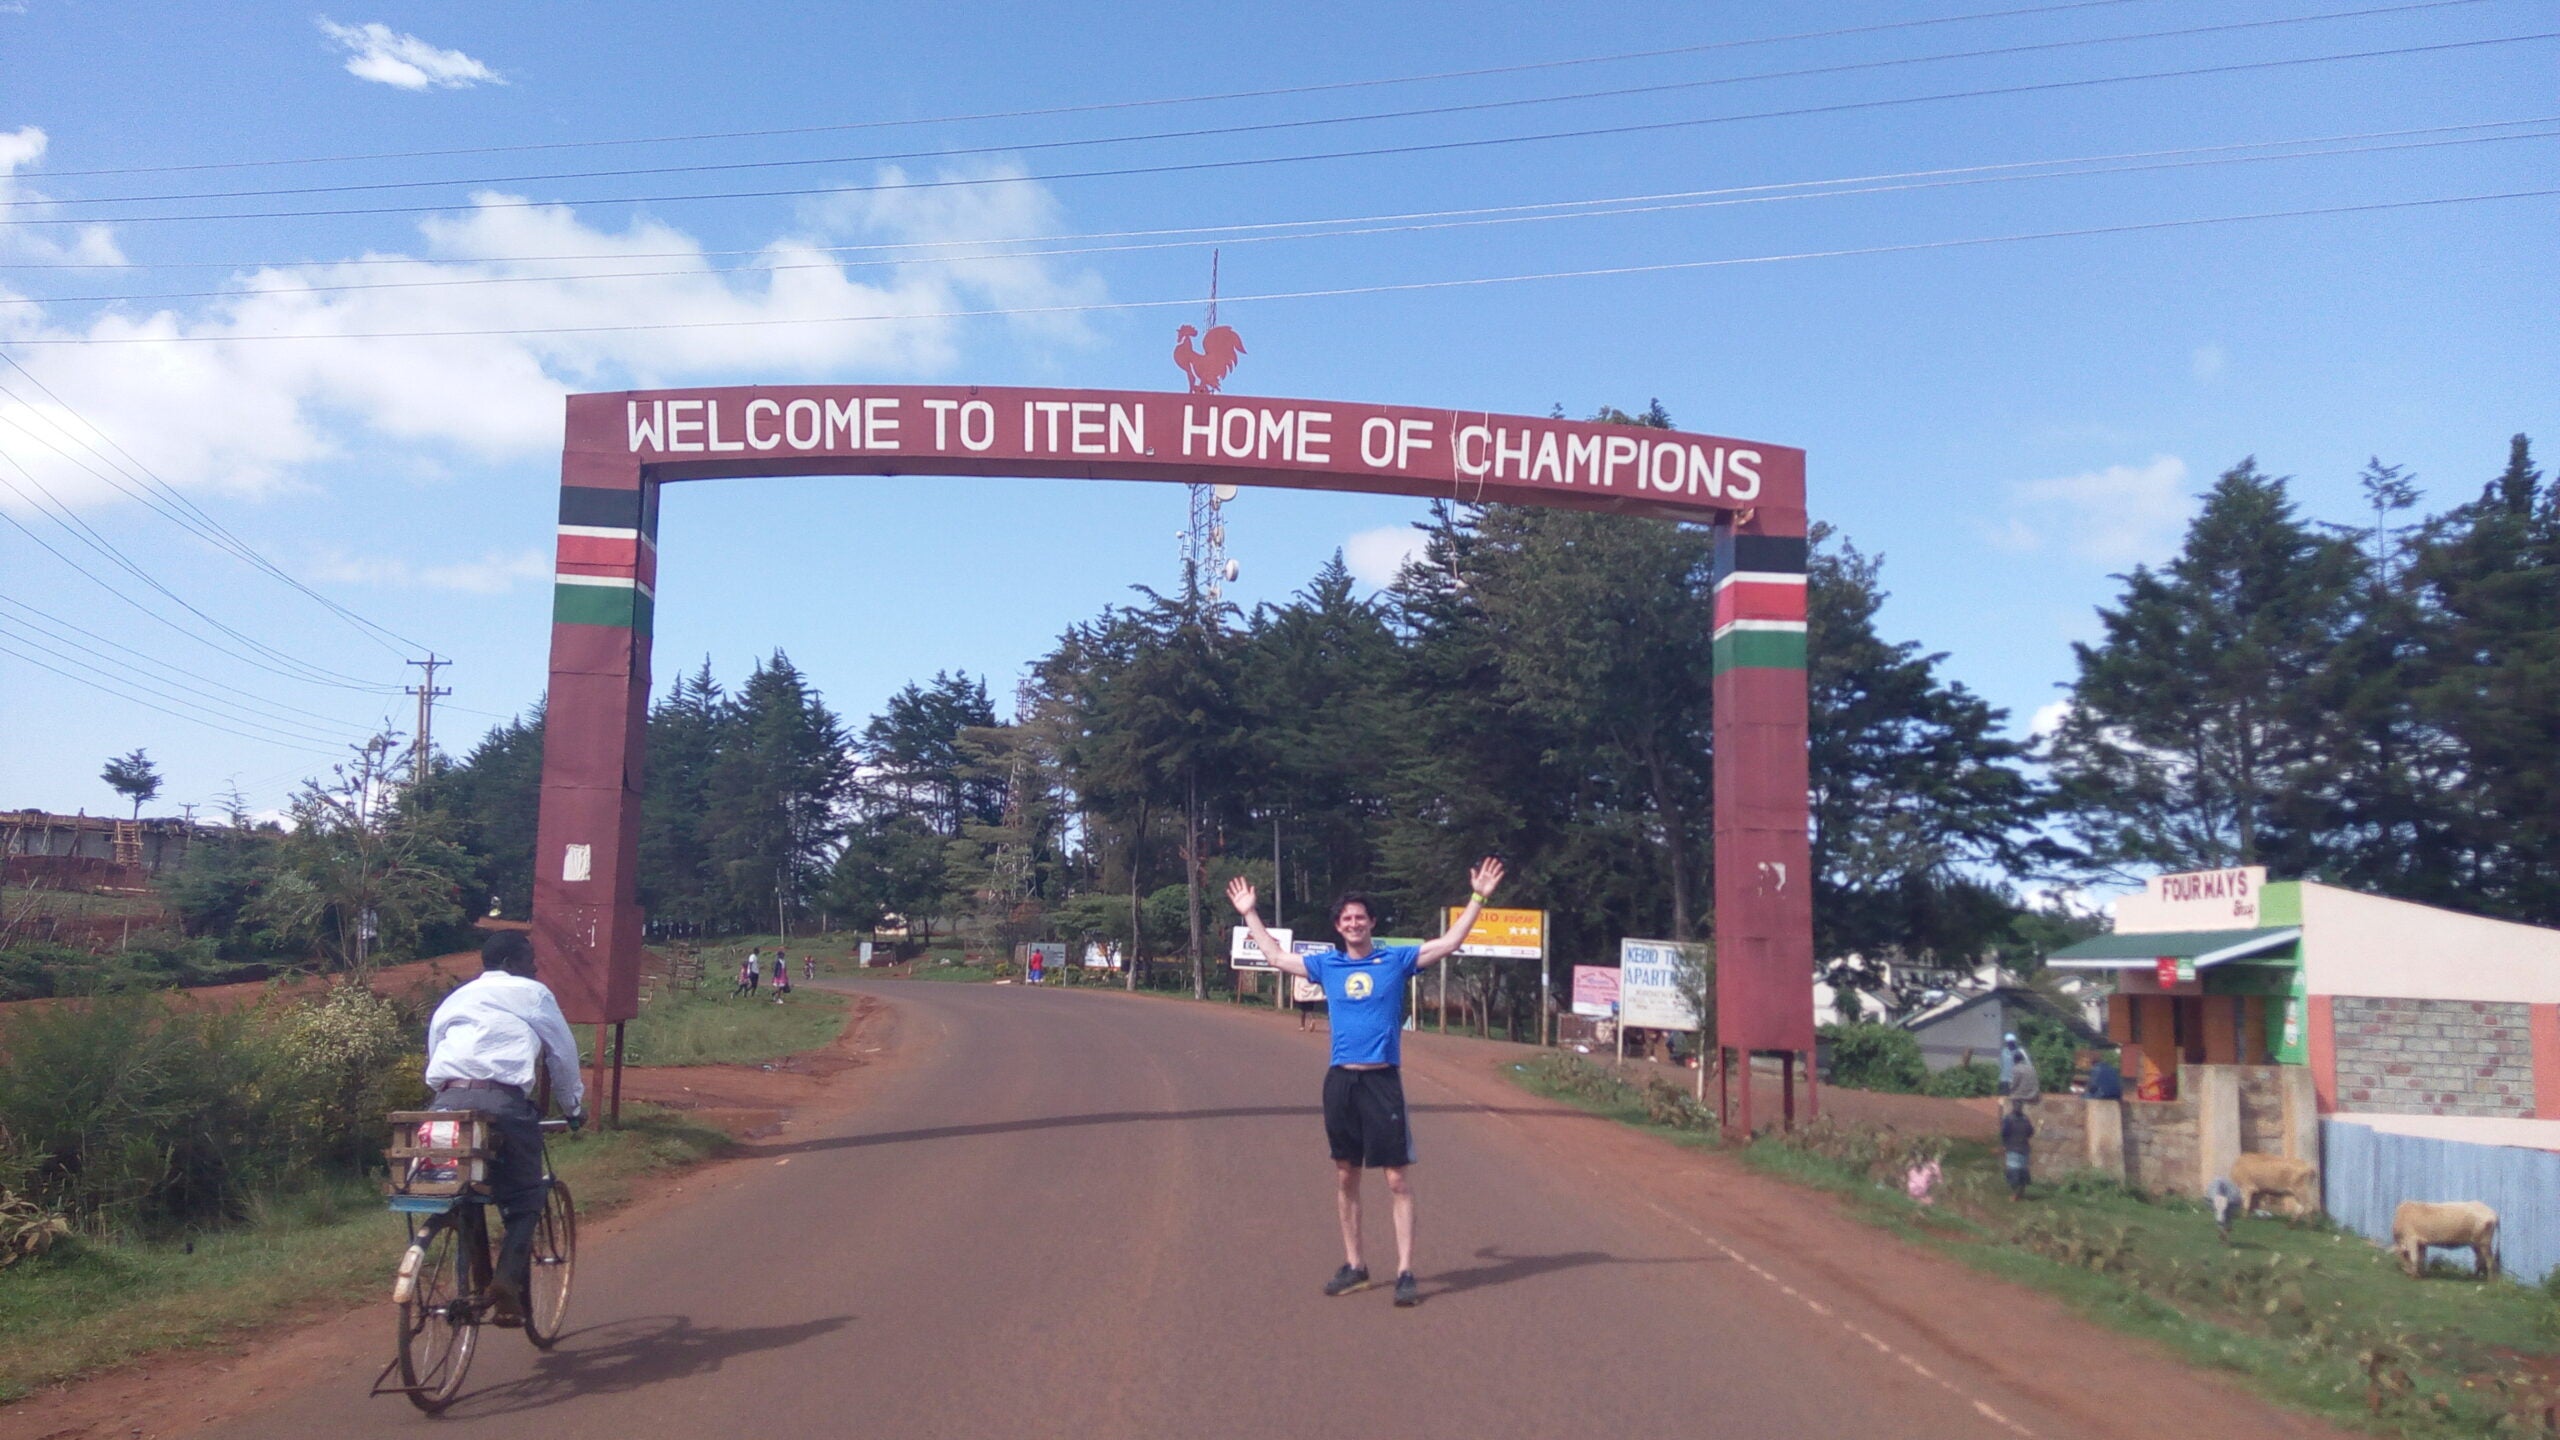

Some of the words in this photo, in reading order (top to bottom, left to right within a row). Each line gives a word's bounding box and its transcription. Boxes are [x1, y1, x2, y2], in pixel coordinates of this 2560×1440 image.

[627, 399, 899, 453] WELCOME
[923, 400, 994, 451] TO
[1181, 405, 1333, 463] HOME
[1360, 417, 1434, 470] OF
[1458, 426, 1762, 500] CHAMPIONS
[1626, 946, 1658, 963] KERIO
